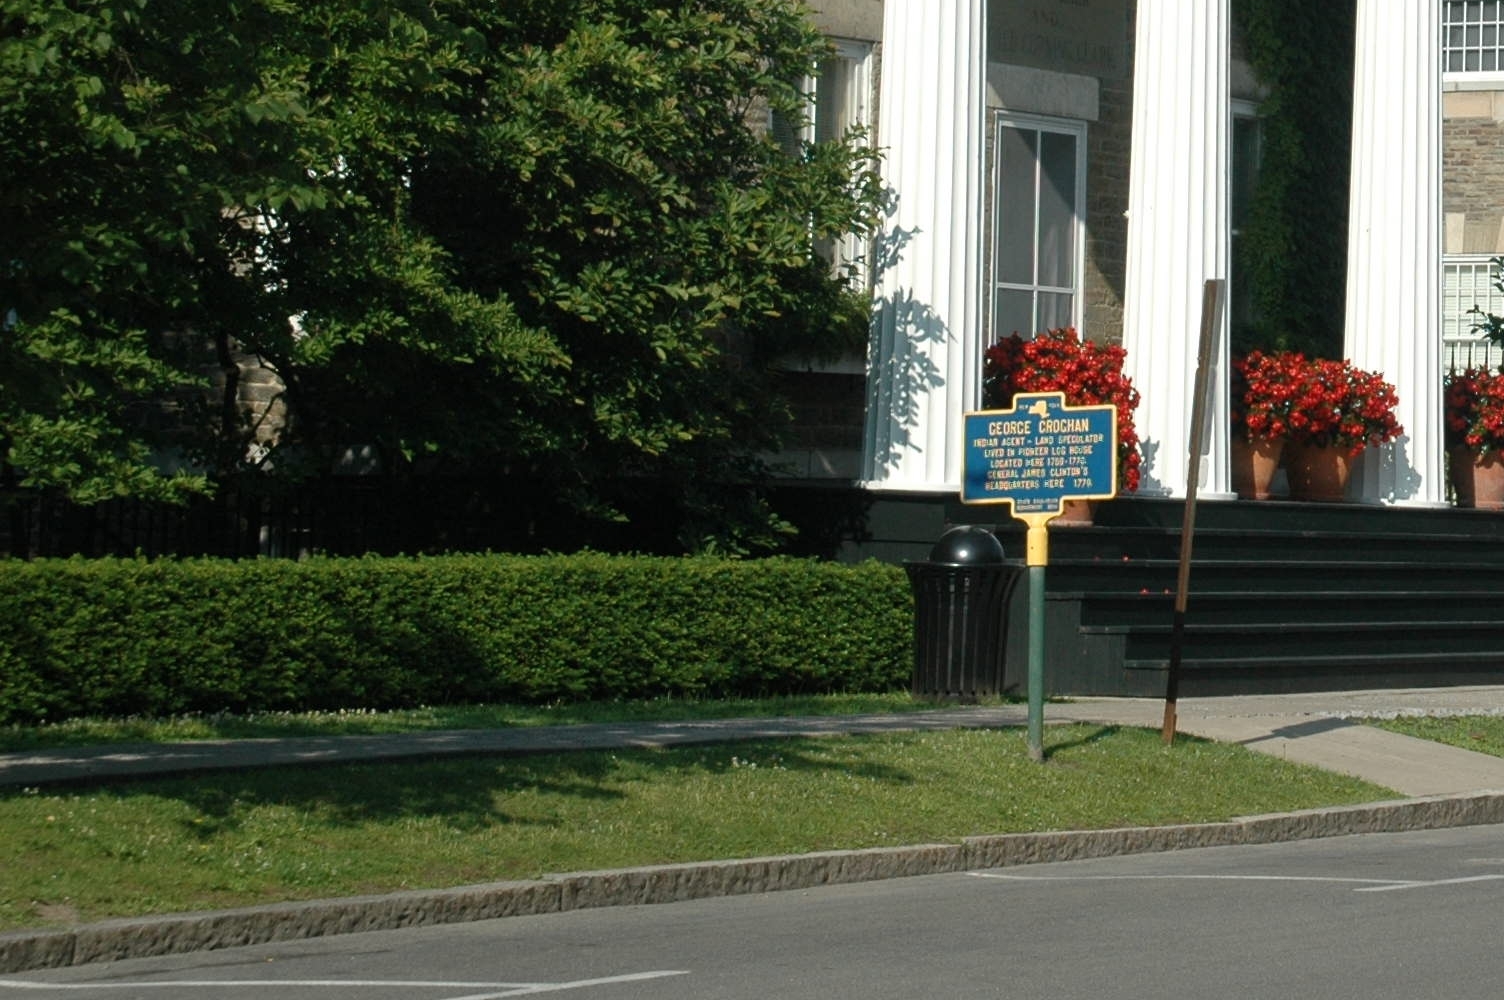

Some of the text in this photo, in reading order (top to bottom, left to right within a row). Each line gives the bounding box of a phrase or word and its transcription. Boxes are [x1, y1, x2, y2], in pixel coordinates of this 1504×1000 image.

[988, 418, 1089, 436] GEORGE CROGHAN
[973, 437, 998, 448] INDIAN
[1001, 436, 1025, 447] AGENT
[1035, 436, 1054, 446] LAND
[1058, 433, 1104, 445] SPECULATOR
[984, 445, 1093, 458] LIVED IN PIONEER LOG HOUSE
[990, 458, 1023, 468] LOCATED
[1025, 457, 1045, 467] HERE
[987, 466, 1088, 479] GENERAL JAMES CLINTON'S
[984, 480, 1040, 491] HEADQUARTERS
[1044, 478, 1065, 488] HERE
